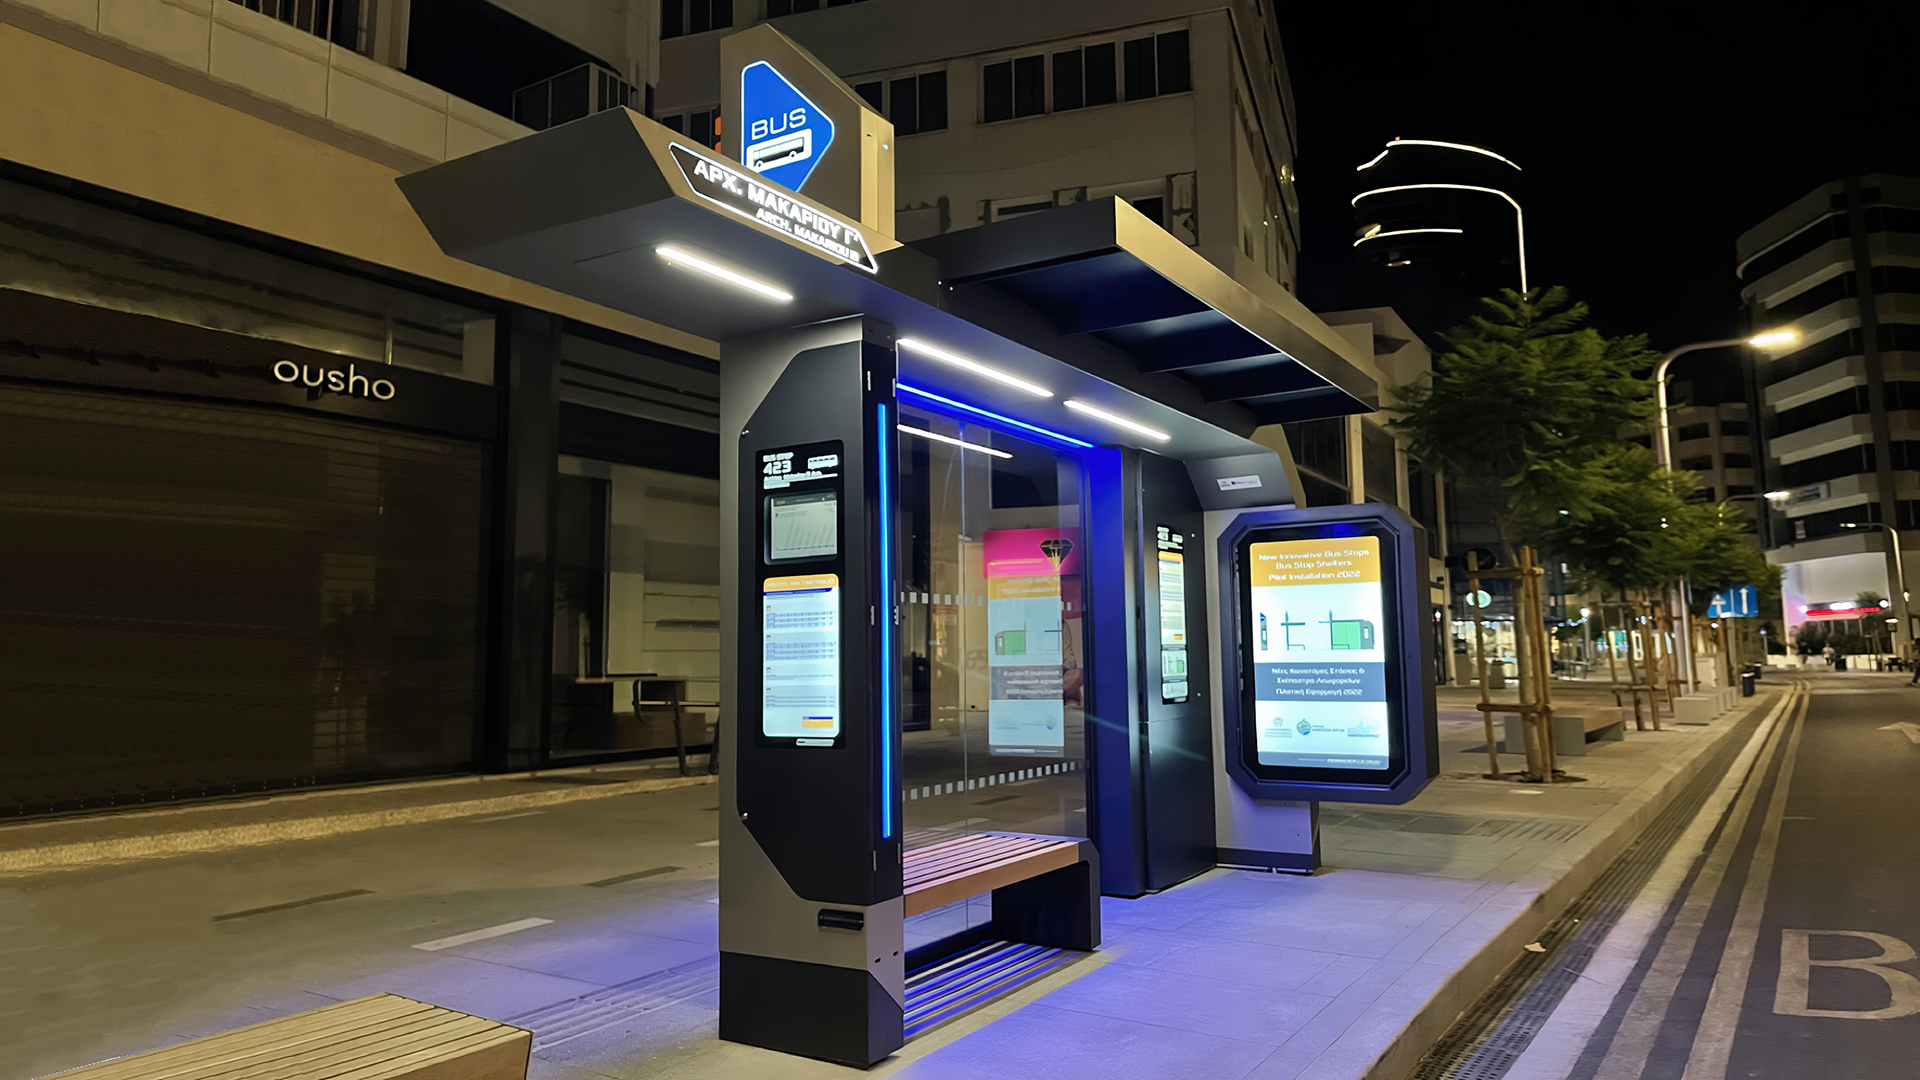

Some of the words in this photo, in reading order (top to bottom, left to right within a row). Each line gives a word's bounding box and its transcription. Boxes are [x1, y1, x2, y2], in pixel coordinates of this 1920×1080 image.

[751, 107, 807, 140] BUS
[694, 160, 743, 195] ΑΡΧ.
[748, 183, 841, 239] ΜΑΚΑΡΙΟΥ
[756, 208, 792, 232] ARCH.
[273, 359, 396, 401] oysho
[763, 460, 791, 475] 423
[1324, 550, 1342, 558] Bus
[1343, 549, 1370, 558] Stops
[1294, 561, 1315, 570] Stop
[1316, 560, 1352, 568] Shelters
[1268, 573, 1286, 581] Pilot
[1289, 572, 1335, 580] Installation
[1336, 570, 1361, 578] 2022
